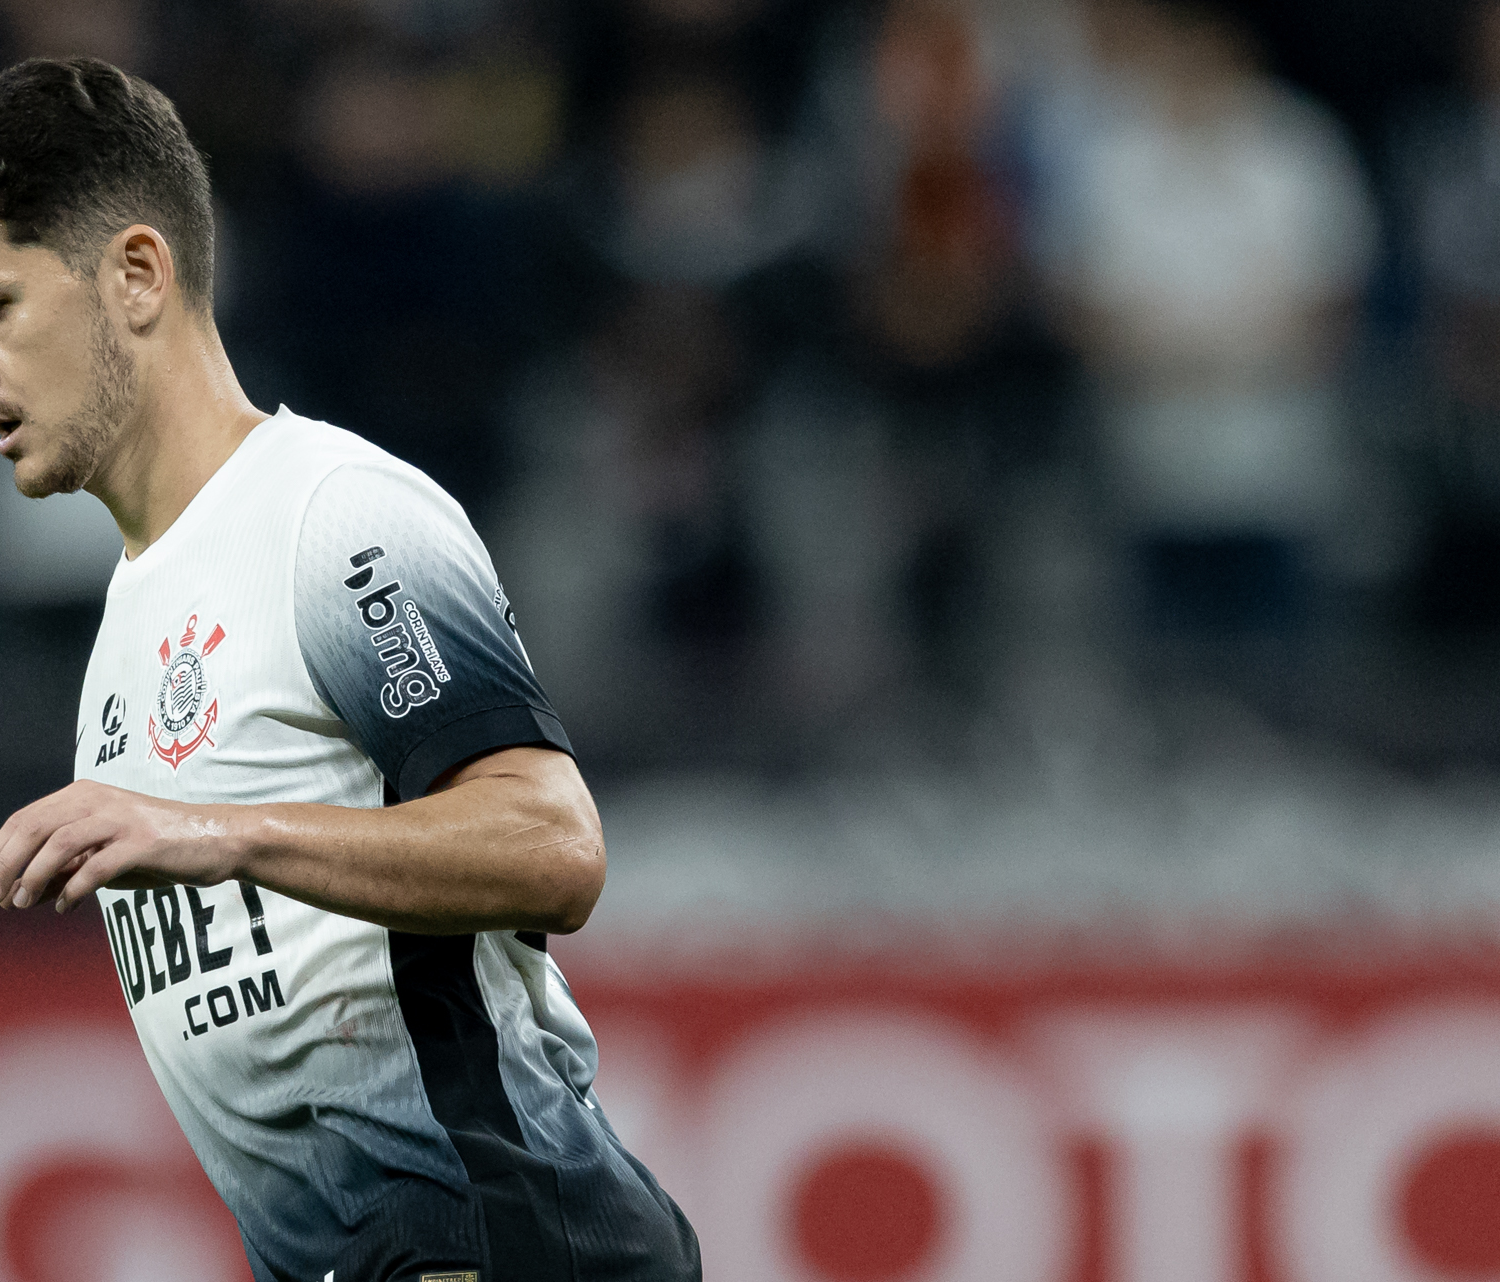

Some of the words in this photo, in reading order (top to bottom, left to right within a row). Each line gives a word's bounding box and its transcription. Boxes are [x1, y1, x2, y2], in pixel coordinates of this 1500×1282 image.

[356, 580, 440, 718] bmg
[403, 600, 451, 682] CORINTHIANS
[95, 733, 128, 767] ALE
[170, 719, 186, 731] 1910
[183, 969, 286, 1041] .COM
